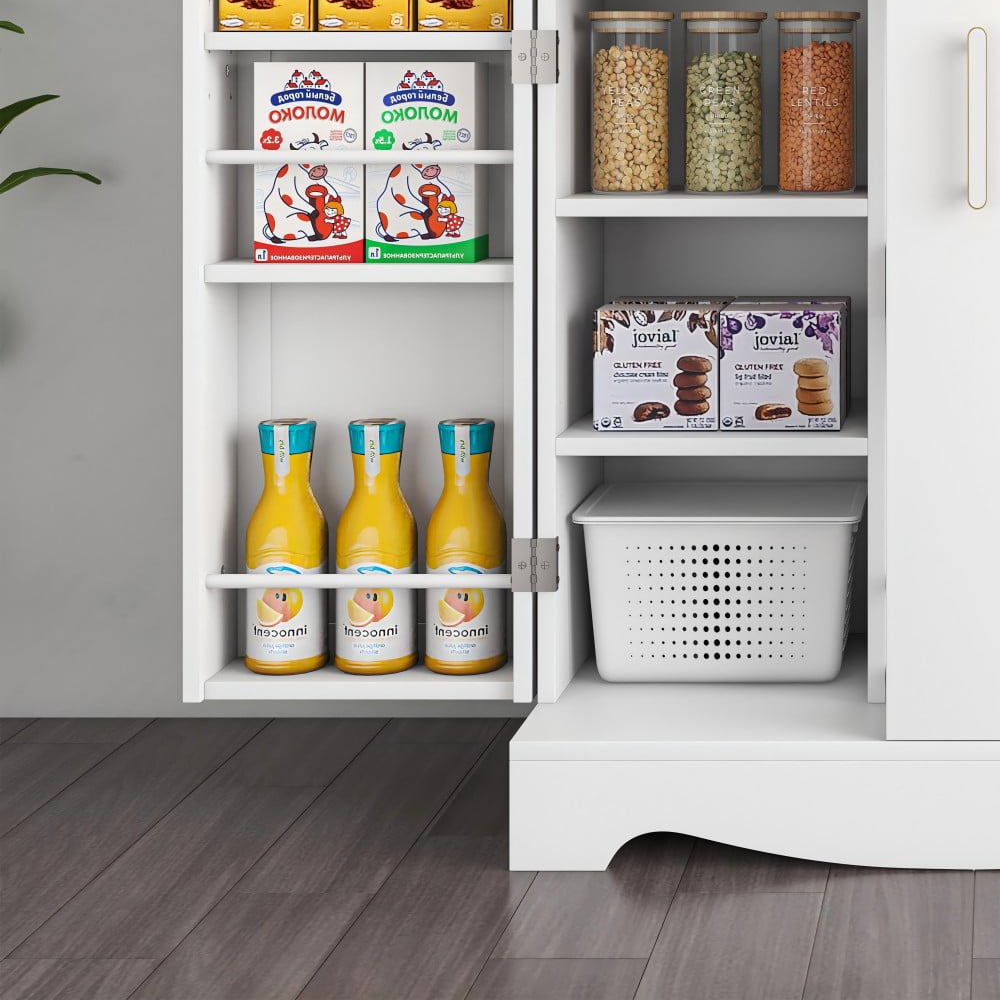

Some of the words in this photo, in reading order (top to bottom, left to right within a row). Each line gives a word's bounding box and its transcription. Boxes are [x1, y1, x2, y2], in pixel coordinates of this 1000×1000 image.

[602, 86, 650, 95] YELLOW
[700, 86, 740, 95] GREEN
[802, 86, 828, 95] RED
[610, 98, 641, 107] PEAS
[704, 98, 736, 107] PEAS
[790, 98, 839, 107] LENTILS
[632, 328, 676, 348] jovial
[753, 332, 799, 350] jovial
